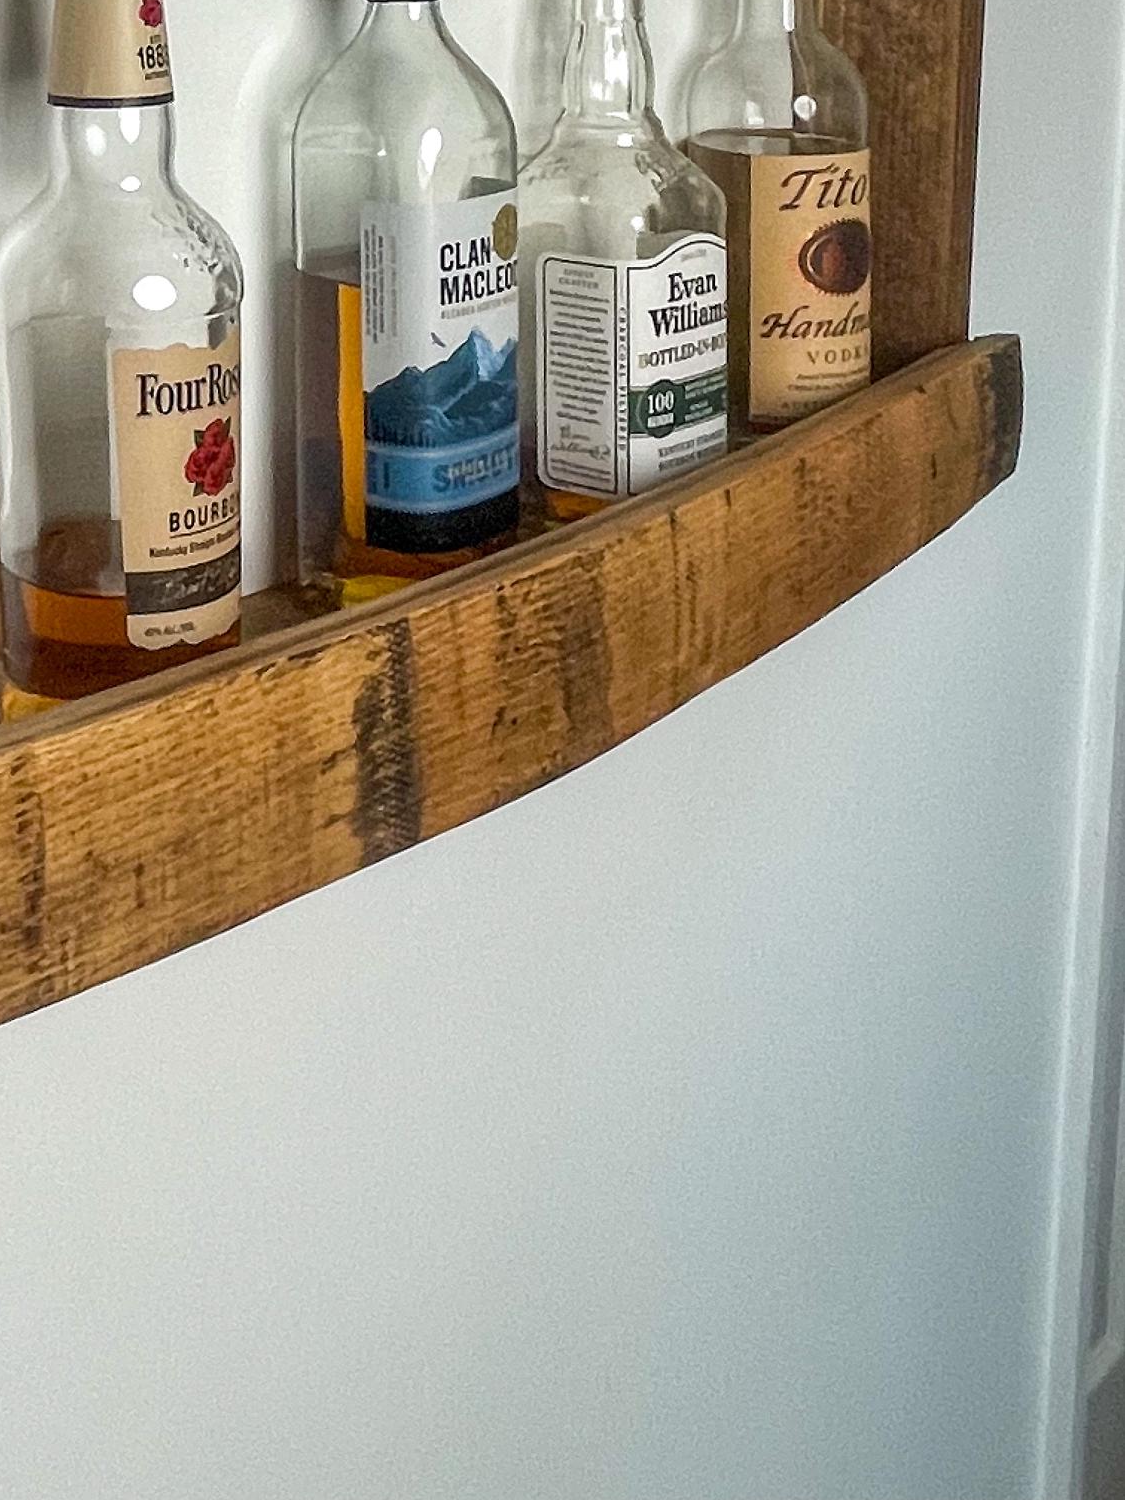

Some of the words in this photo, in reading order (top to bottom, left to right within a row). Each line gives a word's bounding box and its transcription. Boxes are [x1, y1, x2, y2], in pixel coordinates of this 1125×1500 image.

[779, 163, 869, 211] Tito
[440, 236, 491, 272] CLAN
[667, 272, 717, 302] Evan
[135, 373, 206, 417] Four
[648, 390, 675, 414] 100
